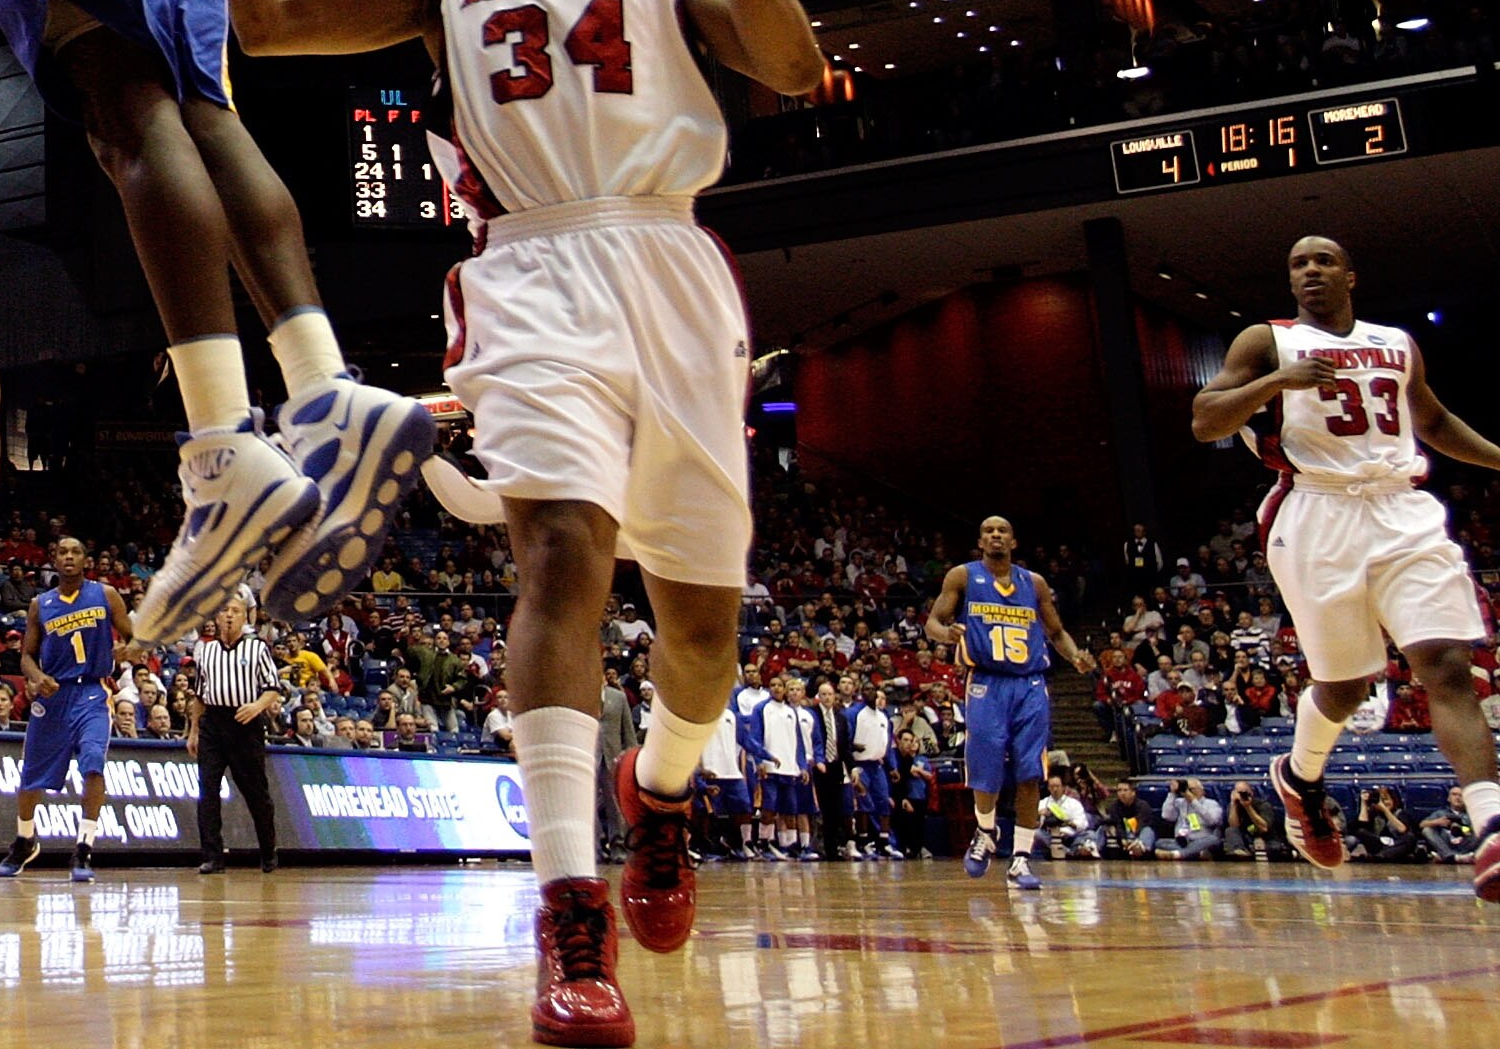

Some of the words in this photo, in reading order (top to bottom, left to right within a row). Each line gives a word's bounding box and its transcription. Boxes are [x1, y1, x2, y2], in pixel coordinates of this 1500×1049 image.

[380, 89, 408, 106] UL
[354, 109, 377, 122] PL
[1323, 103, 1386, 125] MOREHEAD
[362, 124, 373, 142] 1
[1364, 124, 1384, 155] 2
[361, 143, 378, 161] 5
[391, 143, 401, 161] 1
[1122, 134, 1183, 155] LOUISVILLE
[1161, 155, 1182, 184] 4
[1220, 157, 1259, 173] PERIOD
[1288, 147, 1296, 168] 1
[354, 162, 385, 180] 24
[392, 163, 403, 180] 1
[421, 163, 432, 180] 1
[355, 181, 386, 199] 33
[356, 199, 387, 218] 34
[419, 200, 437, 219] 3
[1317, 376, 1401, 437] 33
[44, 608, 106, 634] MOREHEAD
[58, 618, 97, 637] STATE
[983, 613, 1030, 629] STATE
[70, 630, 87, 665] 1
[988, 625, 1029, 664] 15
[302, 783, 409, 819] MOREHEAD
[406, 785, 464, 821] STATE
[34, 803, 128, 844] DAYTN,
[125, 803, 179, 839] OHIO
